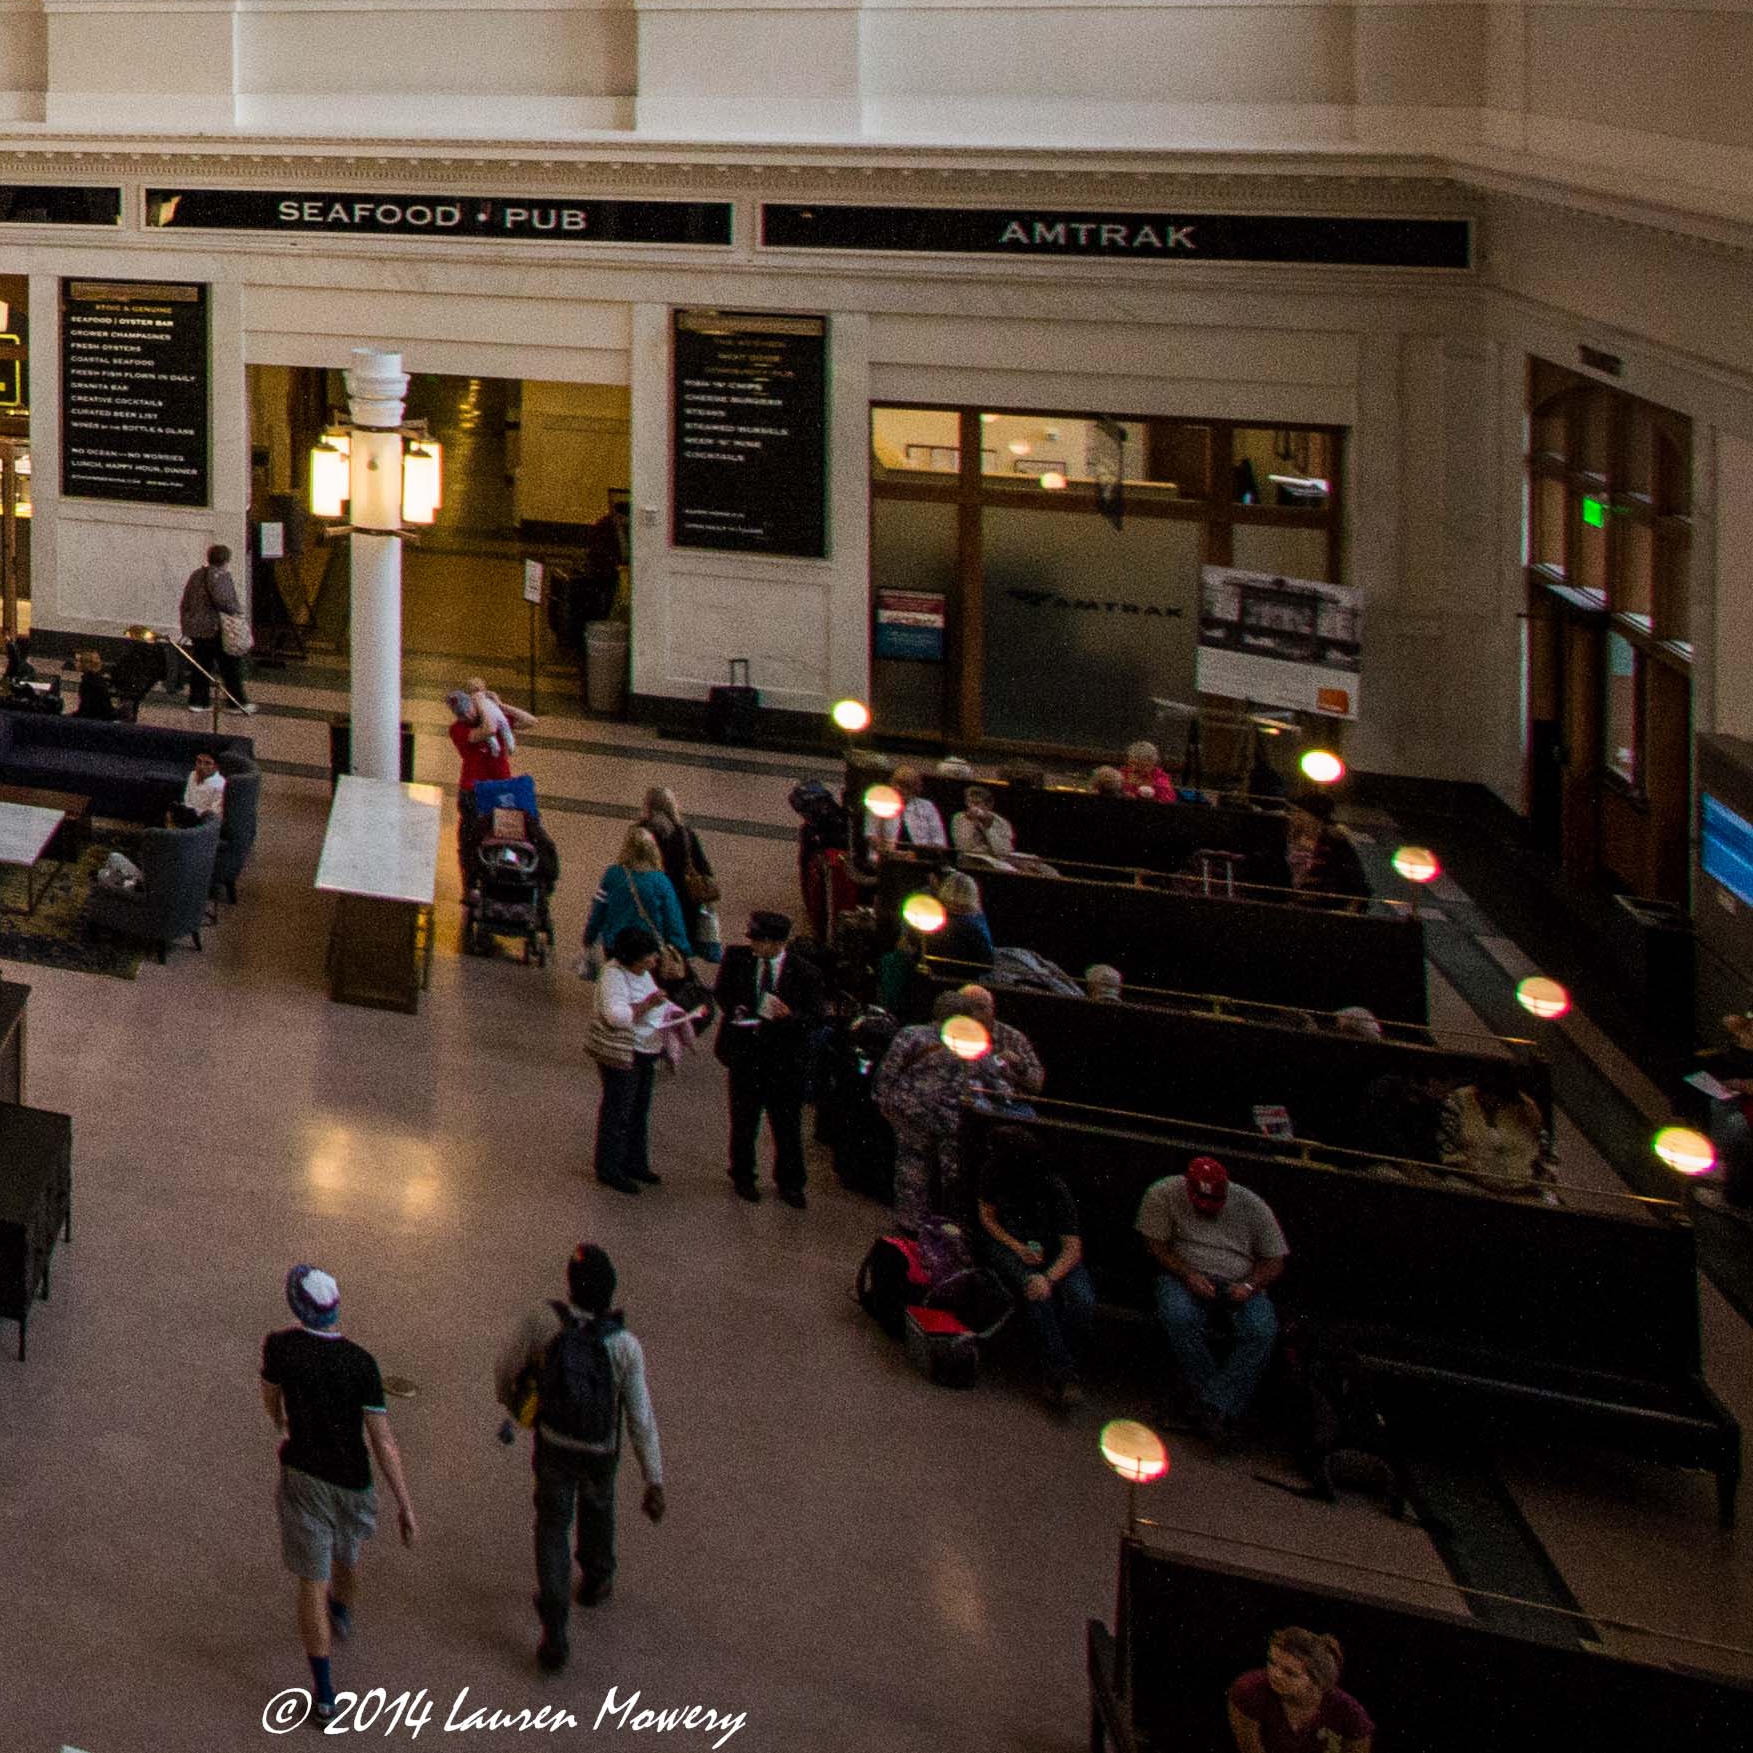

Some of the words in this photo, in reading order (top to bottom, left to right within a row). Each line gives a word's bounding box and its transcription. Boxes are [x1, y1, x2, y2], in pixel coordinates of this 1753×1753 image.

[278, 199, 462, 226] SEAFOOD
[504, 207, 588, 231] PUB
[999, 220, 1199, 249] AMTRAK
[119, 318, 154, 326] OYSTER
[111, 332, 171, 340] CHAMPAGNES
[71, 356, 110, 364] COASTAL
[112, 358, 155, 366] SEAFOOD
[71, 395, 112, 403] CREATIVE
[114, 398, 163, 407] COCKTAILS
[71, 408, 111, 416] CURATED
[164, 467, 198, 475] DINNER
[1052, 596, 1183, 619] AMTRAK
